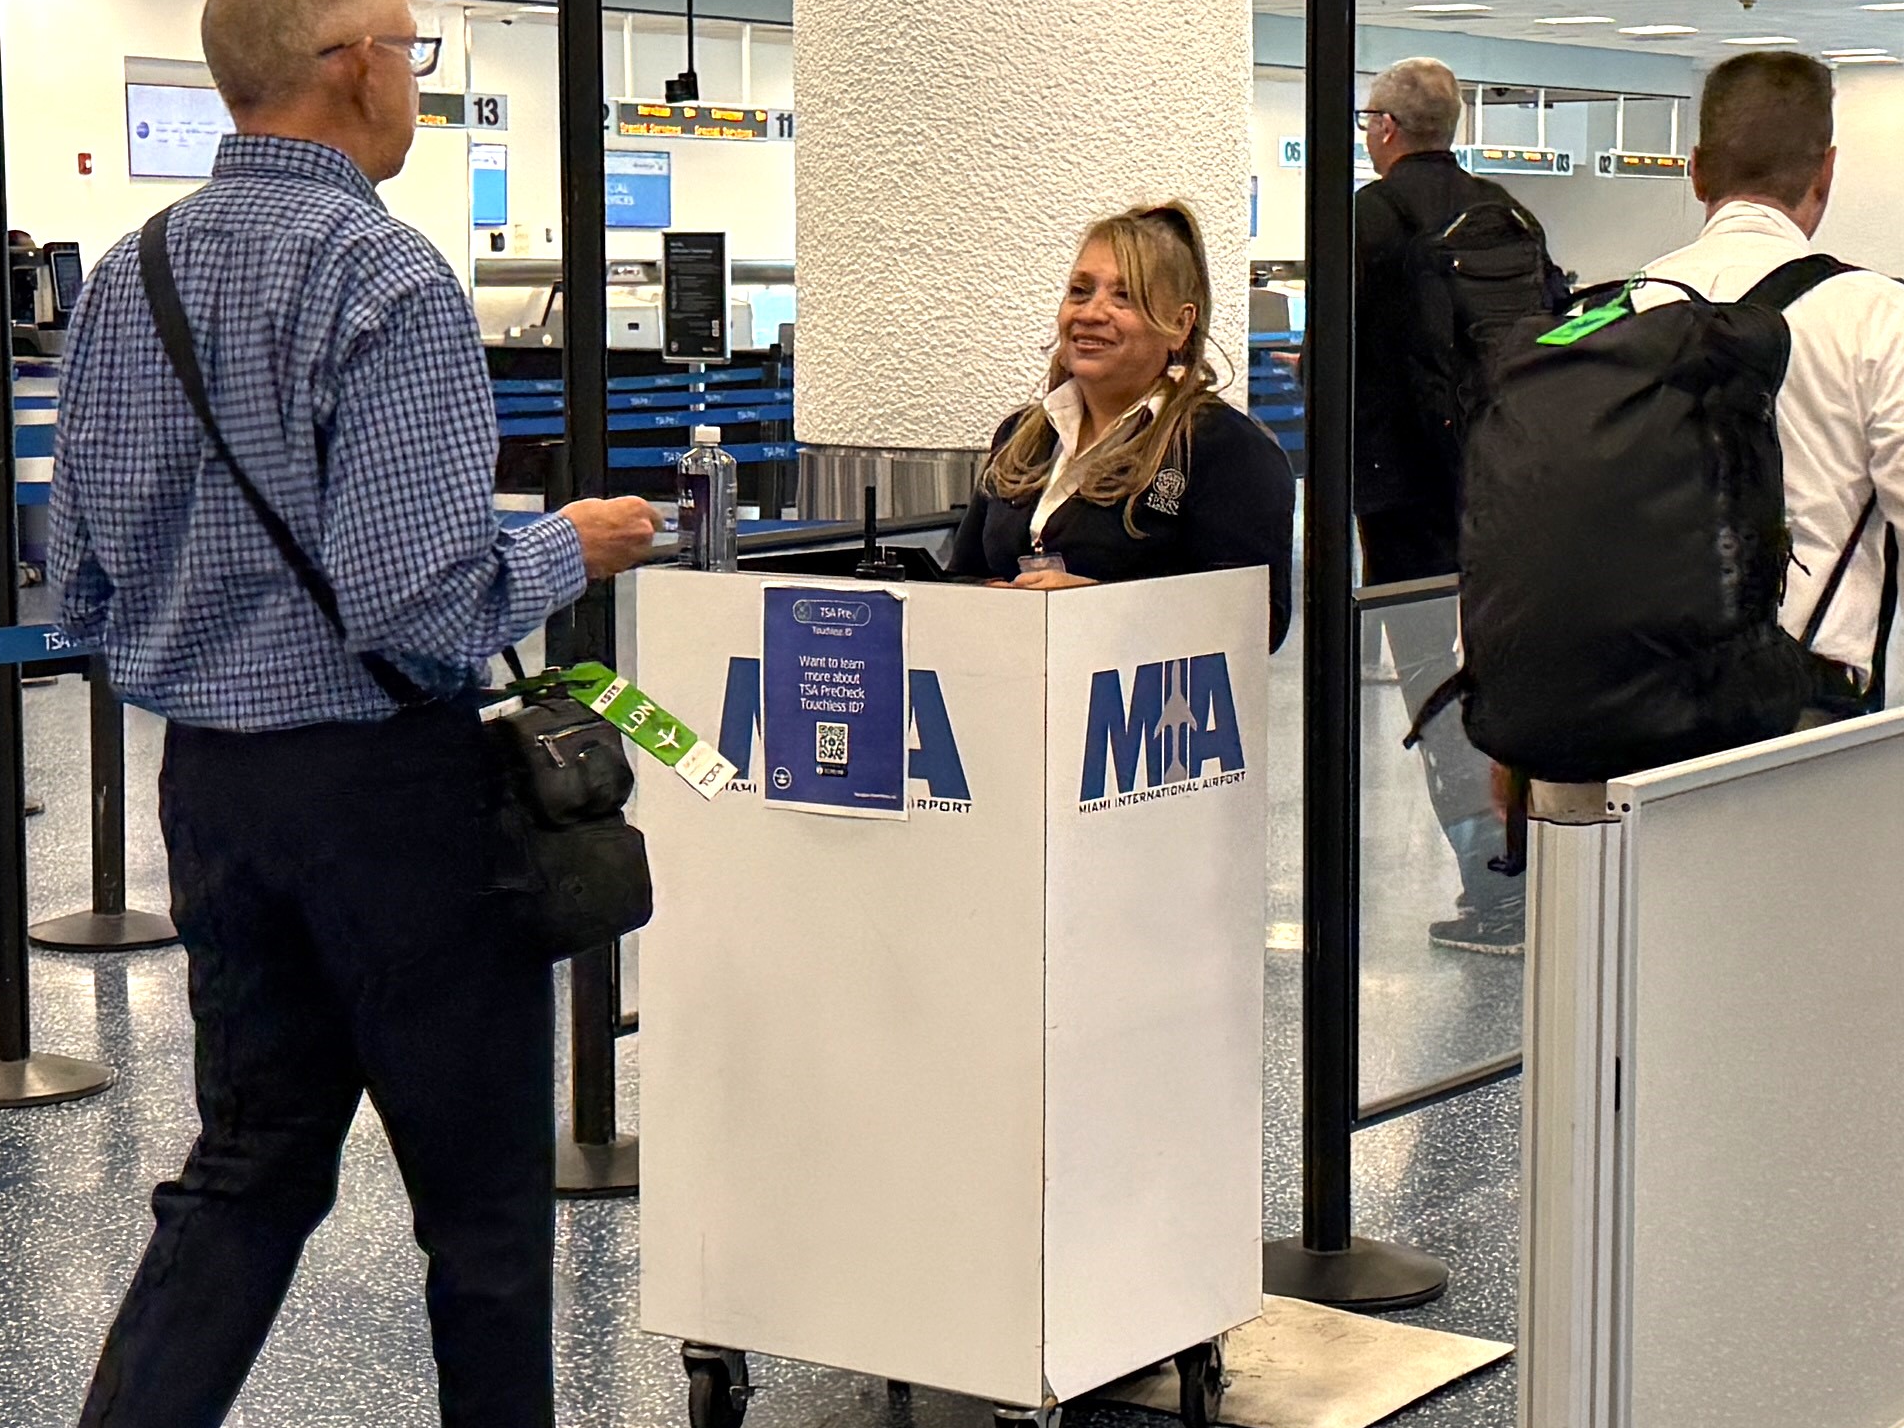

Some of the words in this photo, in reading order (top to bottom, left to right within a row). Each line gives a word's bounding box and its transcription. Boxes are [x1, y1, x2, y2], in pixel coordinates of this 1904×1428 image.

[472, 97, 500, 126] 13
[1284, 141, 1301, 162] 06
[1556, 148, 1570, 172] 03
[1598, 151, 1612, 172] 02
[820, 606, 836, 619] TSA
[837, 608, 852, 619] Pre
[799, 655, 826, 669] Want
[828, 657, 839, 669] to
[840, 658, 865, 670] learn
[804, 672, 831, 683] more
[833, 672, 860, 685] about
[799, 683, 818, 697] TSA
[821, 685, 865, 699] PreCheck
[800, 698, 846, 713] Touchless
[849, 701, 865, 713] ID?
[622, 699, 655, 733] LDN
[1080, 652, 1245, 802] MIA
[725, 782, 757, 793] IAMI
[1079, 800, 1110, 815] MIAMI
[1115, 783, 1199, 808] INTERNATIONAL
[1203, 771, 1246, 790] AIRPORT
[910, 799, 972, 813] IRPORT
